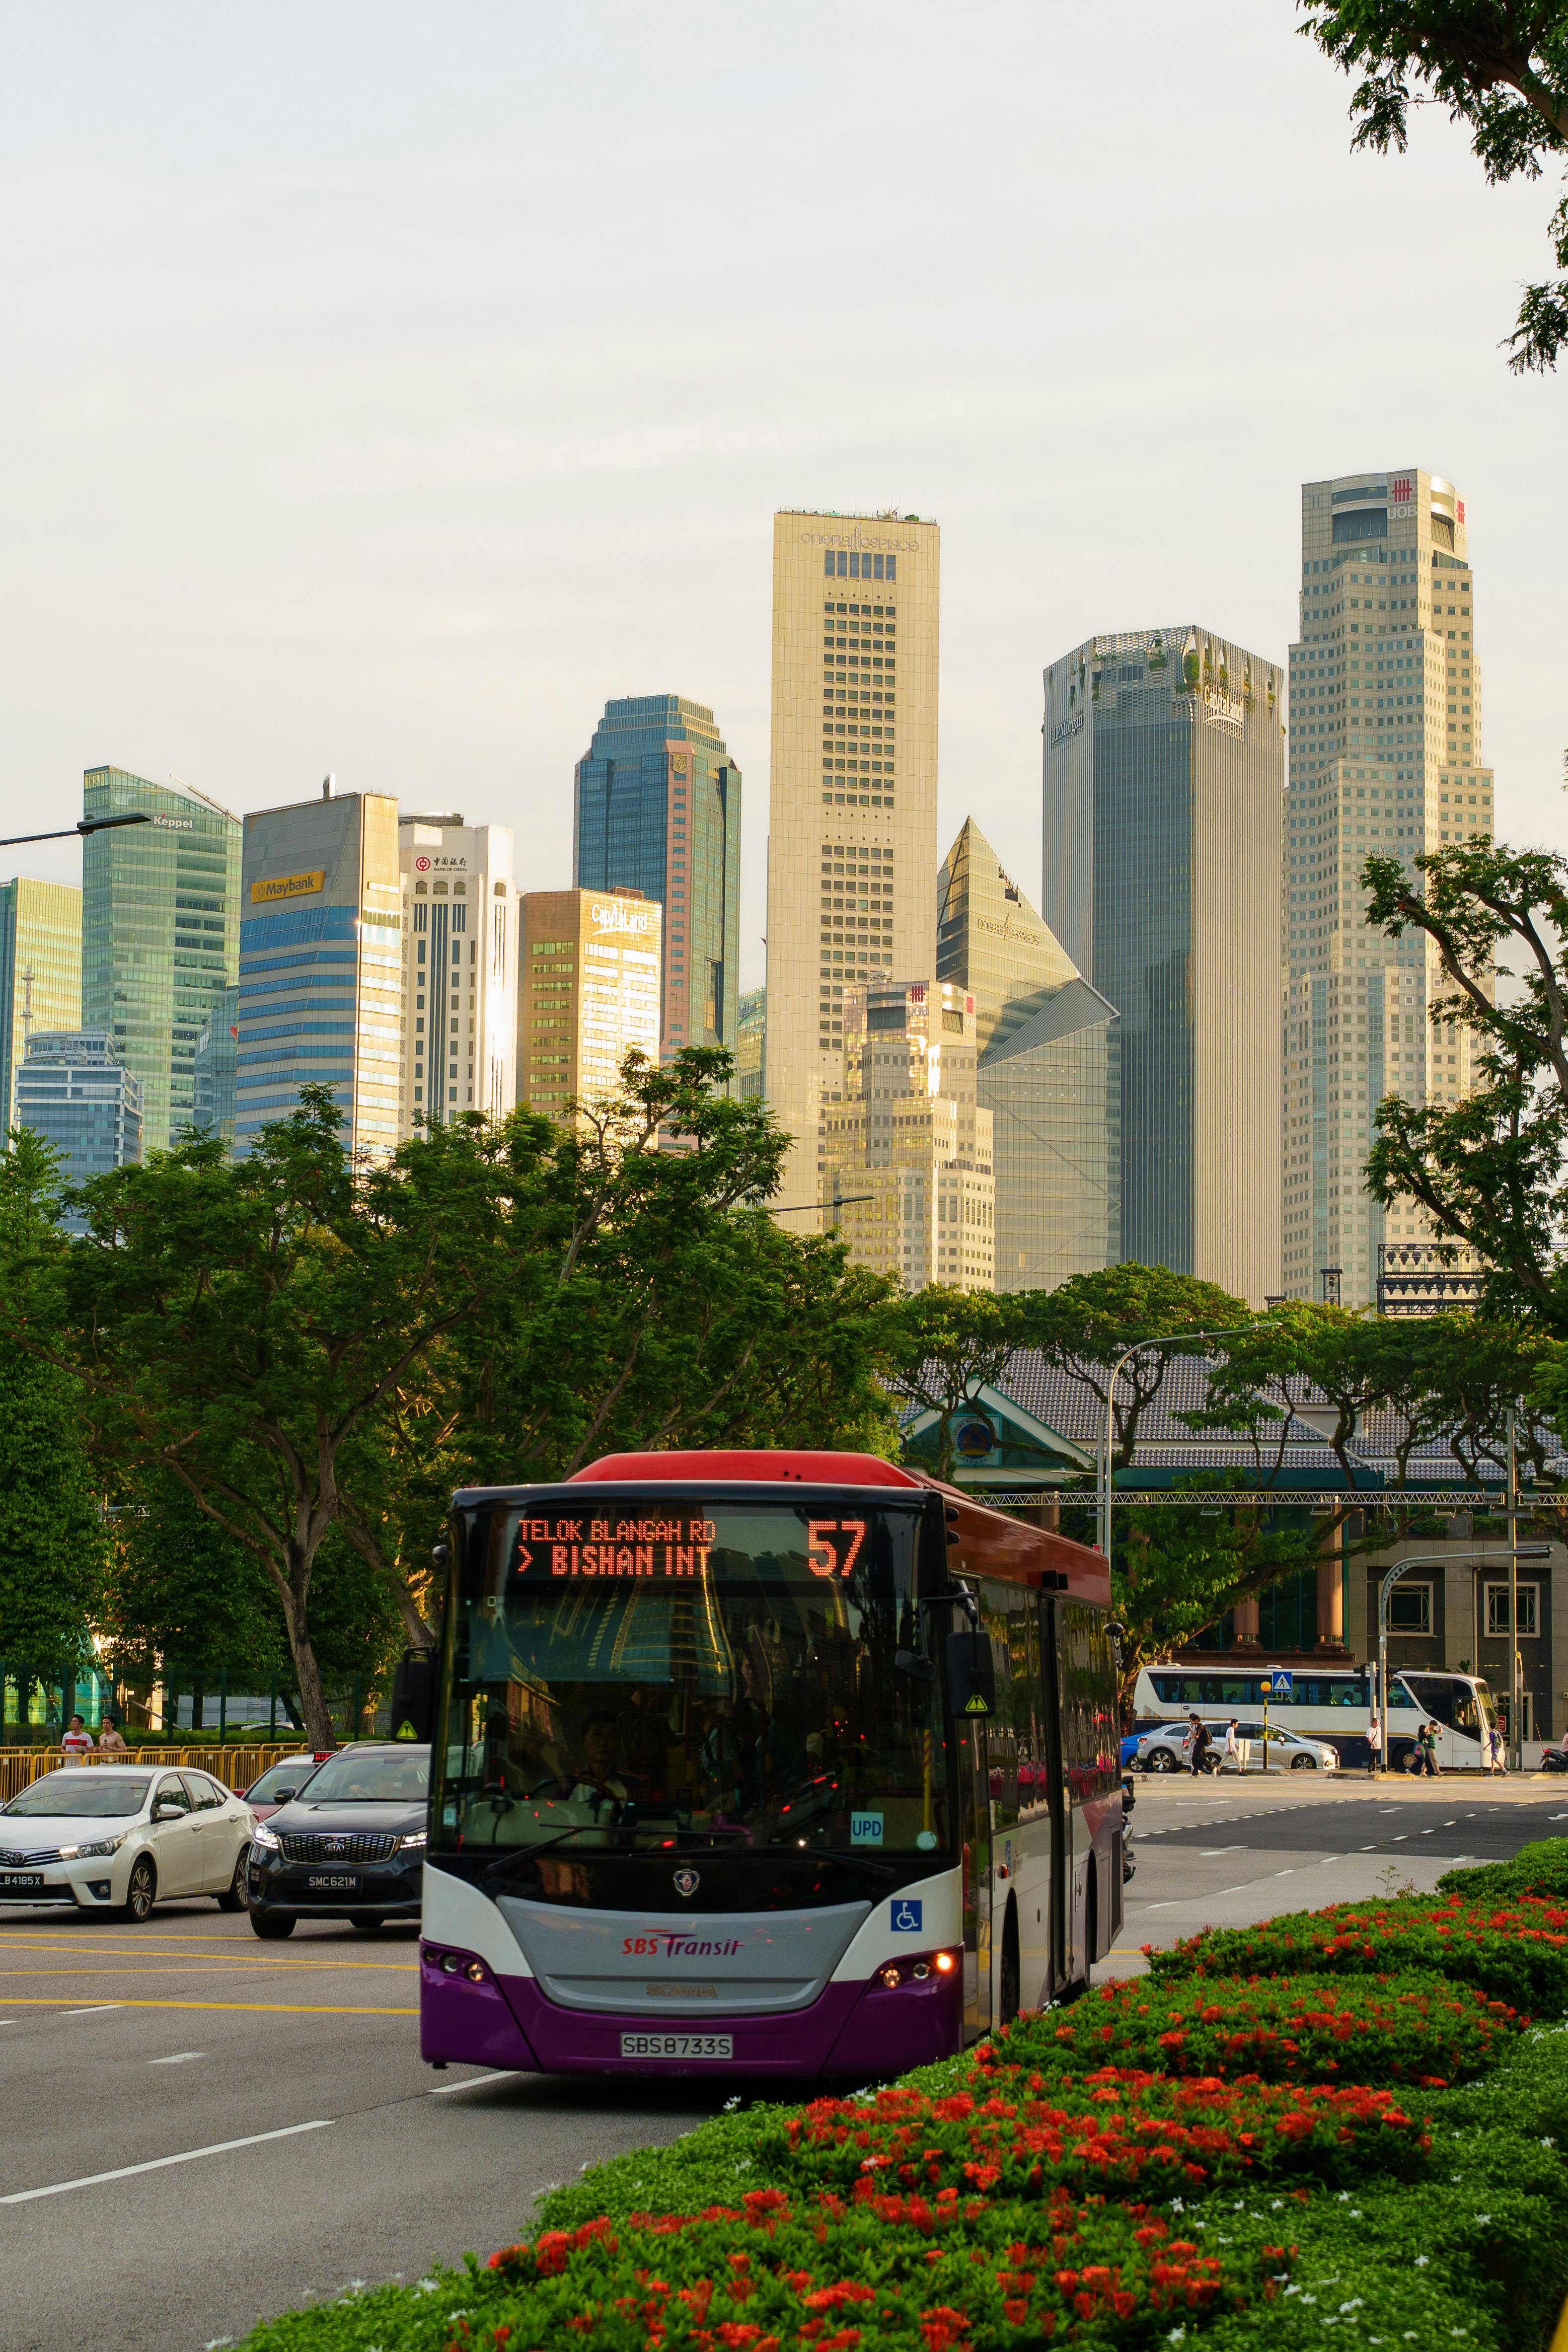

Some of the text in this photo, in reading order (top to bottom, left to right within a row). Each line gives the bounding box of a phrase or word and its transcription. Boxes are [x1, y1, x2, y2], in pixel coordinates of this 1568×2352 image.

[1387, 505, 1417, 520] UOB
[1204, 684, 1244, 724] CapitaLand
[153, 816, 192, 829] Keppel
[266, 875, 314, 896] Maybank
[591, 899, 648, 931] CapitaLand
[906, 1006, 929, 1017] UOB
[964, 1016, 976, 1027] UOB
[518, 1519, 716, 1541] TELOK BLANGAH RD
[808, 1520, 865, 1576] 57
[552, 1546, 711, 1575] BISHAN INT
[853, 1820, 882, 1836] UPD
[622, 1933, 746, 1958] SBS Transit
[646, 1983, 718, 1998] SCANIA
[624, 2037, 730, 2054] SBS8733S
